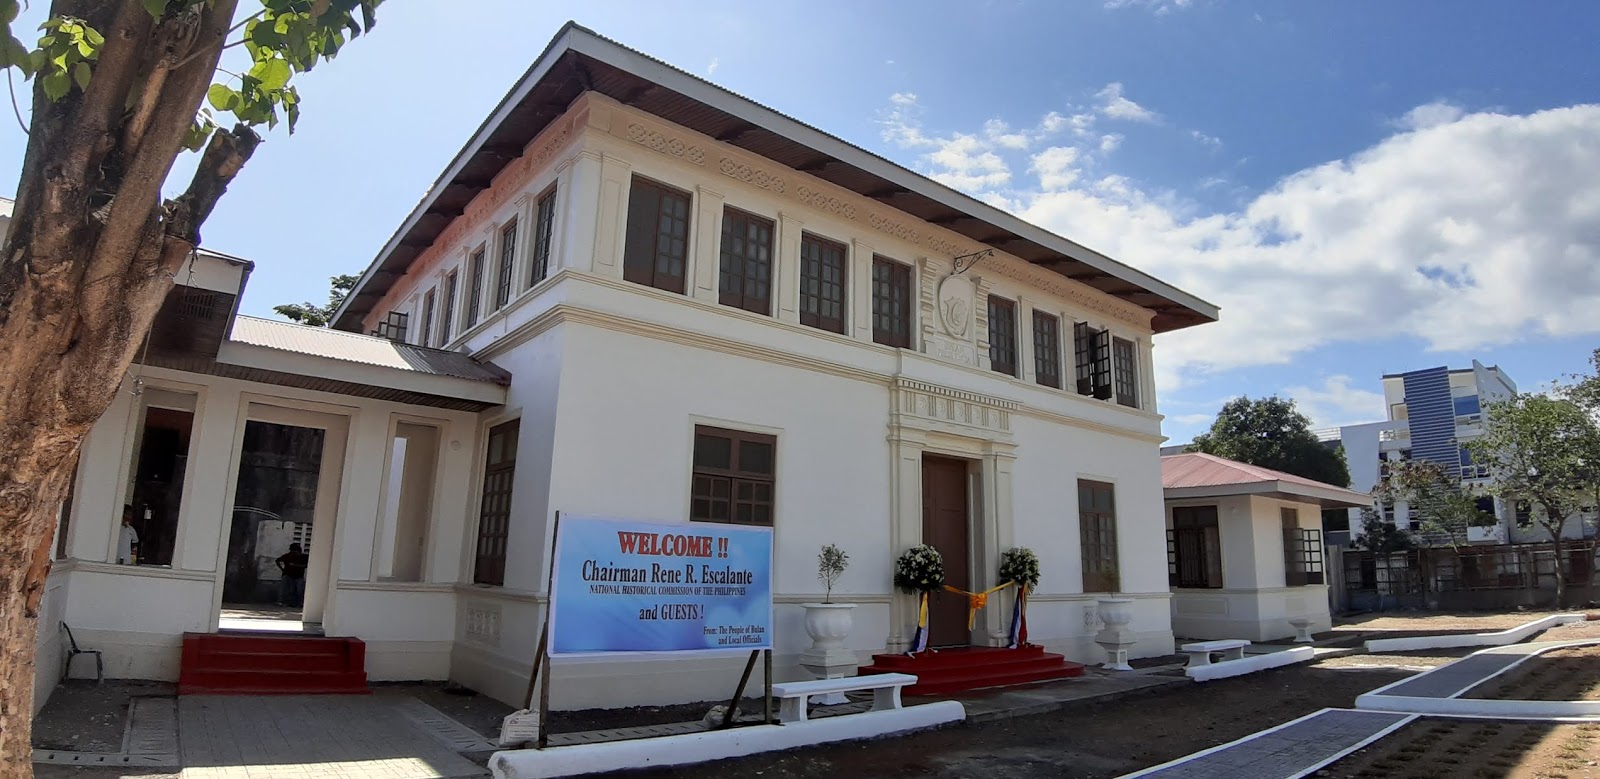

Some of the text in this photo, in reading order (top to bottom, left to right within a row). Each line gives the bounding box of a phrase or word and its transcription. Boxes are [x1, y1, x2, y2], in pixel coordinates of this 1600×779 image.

[618, 531, 729, 559] WELCOME !!
[582, 559, 753, 585] Chairman Rene R. Escalante
[589, 584, 747, 596] NATIONAL HISTORICAL COMMISSION OF THE PHILIPPINES
[639, 603, 704, 620] and GUESTS !
[703, 626, 718, 635] From:
[719, 626, 728, 634] The
[728, 625, 744, 635] People
[745, 624, 751, 634] of
[718, 635, 762, 645] and Local Officials
